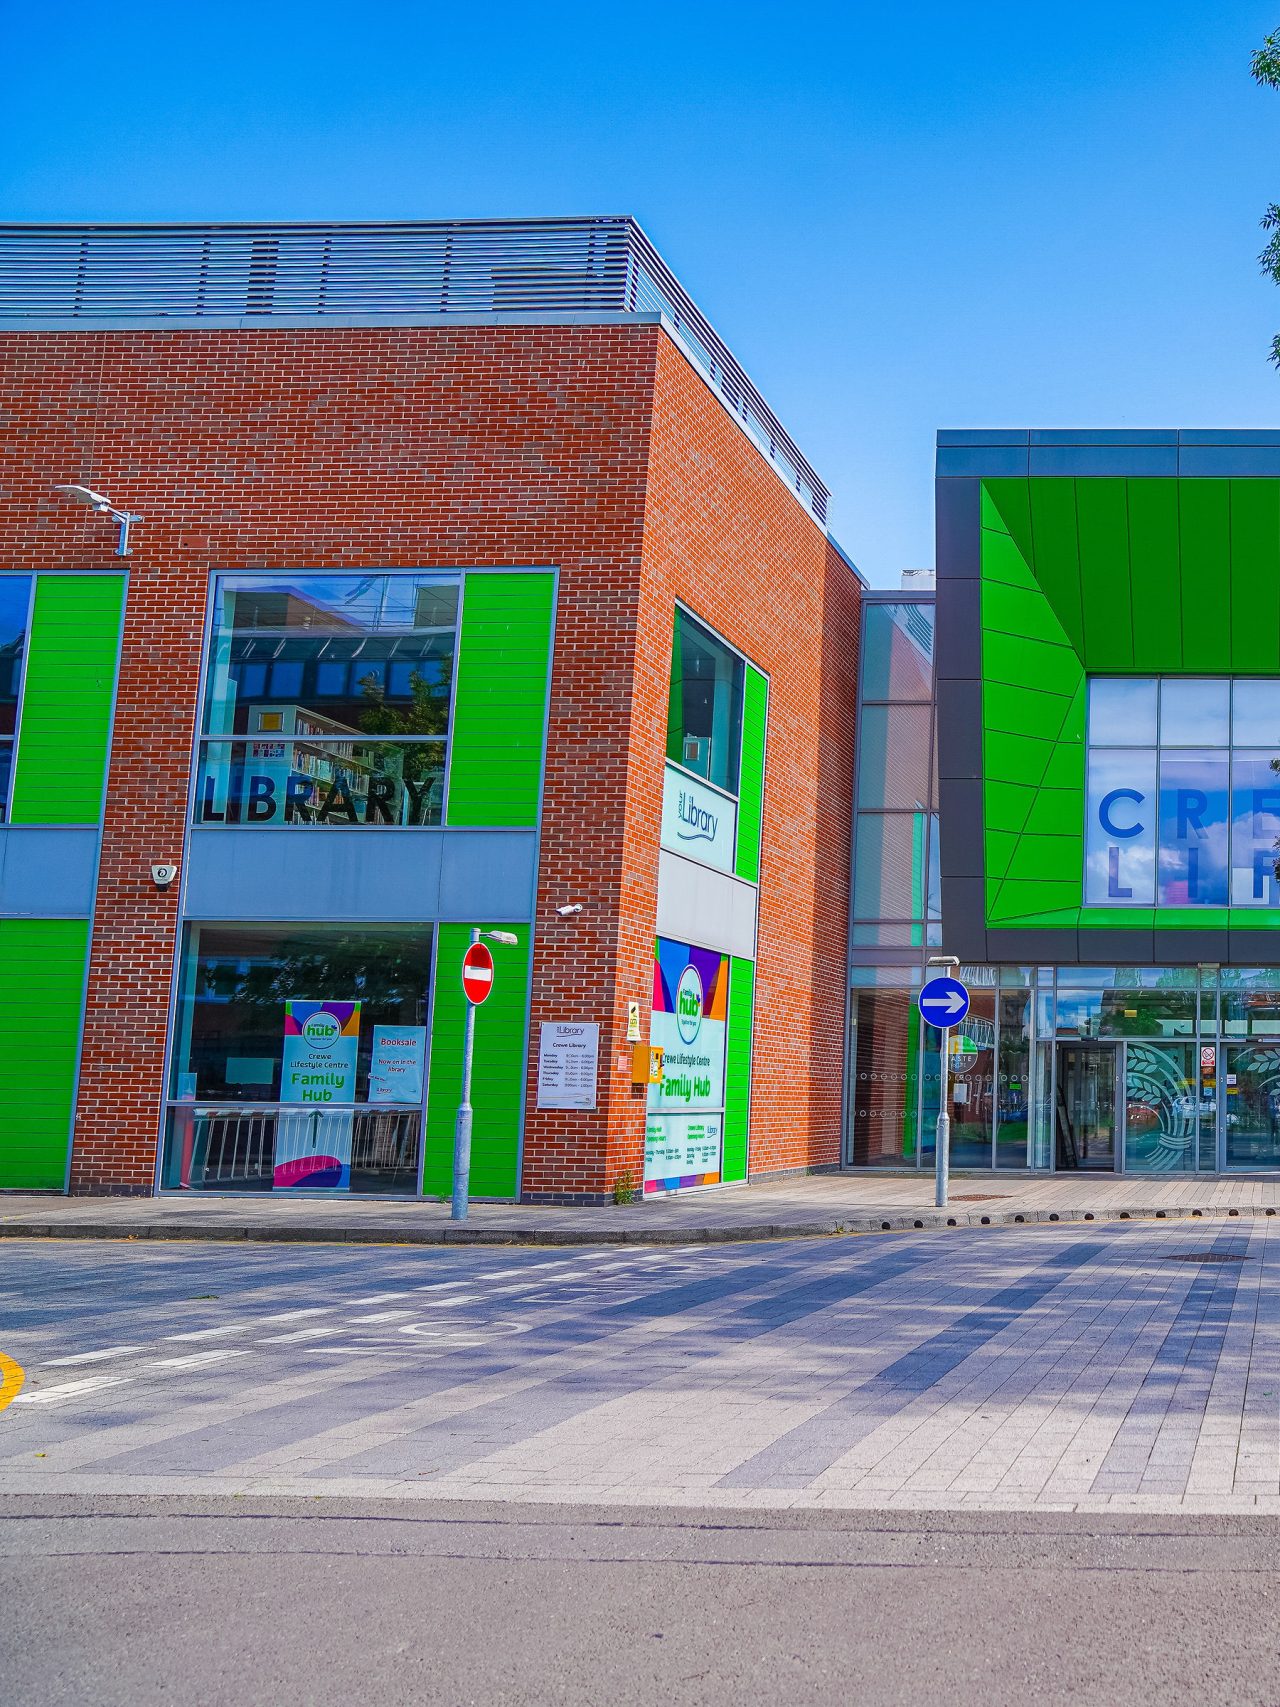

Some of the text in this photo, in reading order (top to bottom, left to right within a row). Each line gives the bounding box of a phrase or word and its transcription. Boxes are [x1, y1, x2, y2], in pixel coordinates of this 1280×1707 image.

[203, 775, 437, 822] LIBRARY
[683, 792, 718, 841] Library
[679, 991, 698, 1017] hub
[307, 1024, 334, 1036] hub
[559, 1026, 585, 1036] Library
[380, 1037, 417, 1046] Booksale
[290, 1061, 323, 1069] Lifestyle
[676, 1053, 696, 1068] Lifestyle
[696, 1056, 710, 1067] Centre
[291, 1073, 345, 1089] Family
[660, 1074, 711, 1102] Family Hub
[302, 1089, 333, 1102] Hub
